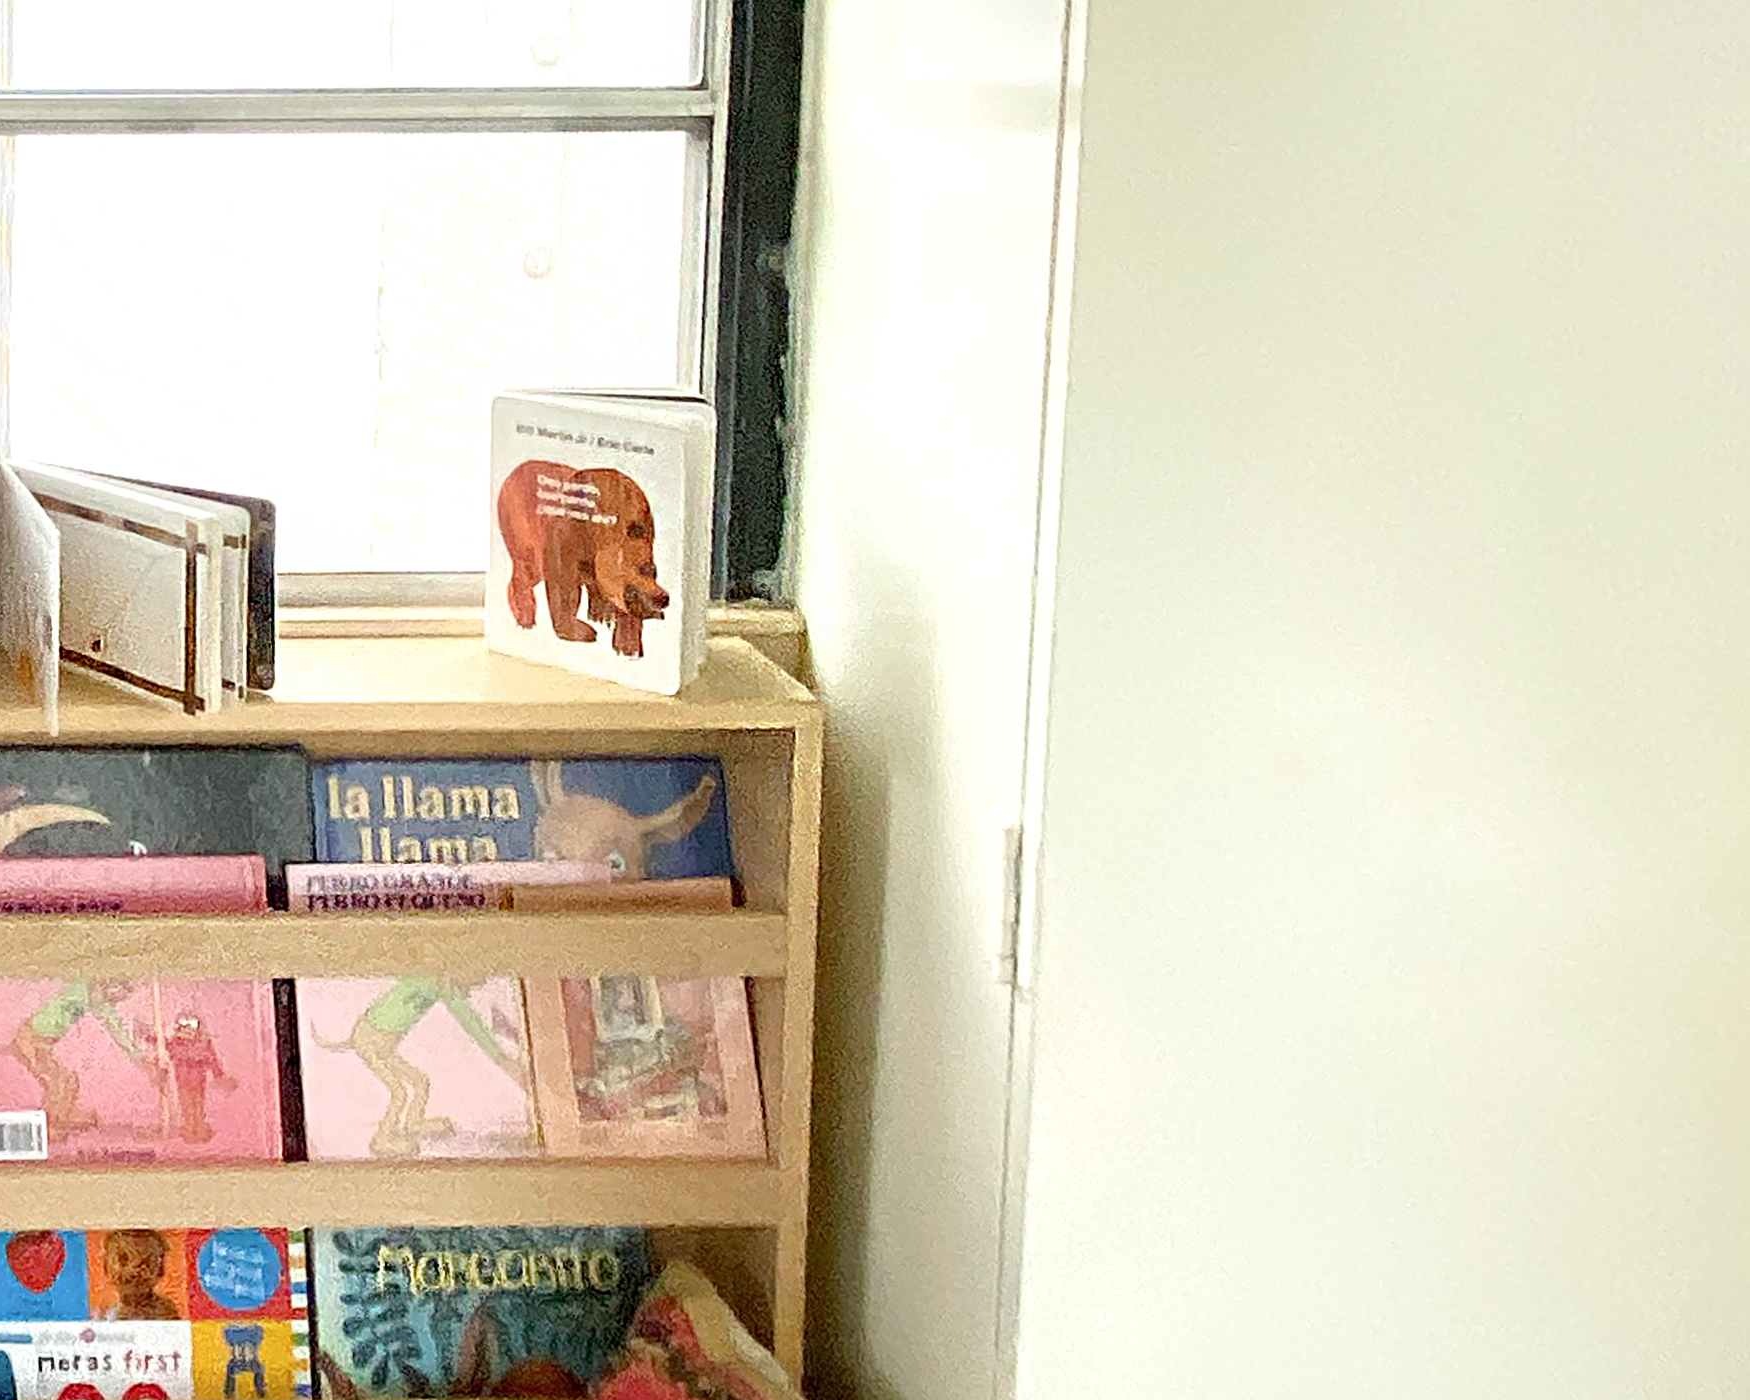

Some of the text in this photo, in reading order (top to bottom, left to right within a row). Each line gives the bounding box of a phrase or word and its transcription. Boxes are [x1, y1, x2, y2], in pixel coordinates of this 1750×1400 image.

[328, 775, 521, 820] la llama
[360, 826, 498, 863] llama
[123, 1349, 181, 1374] first
